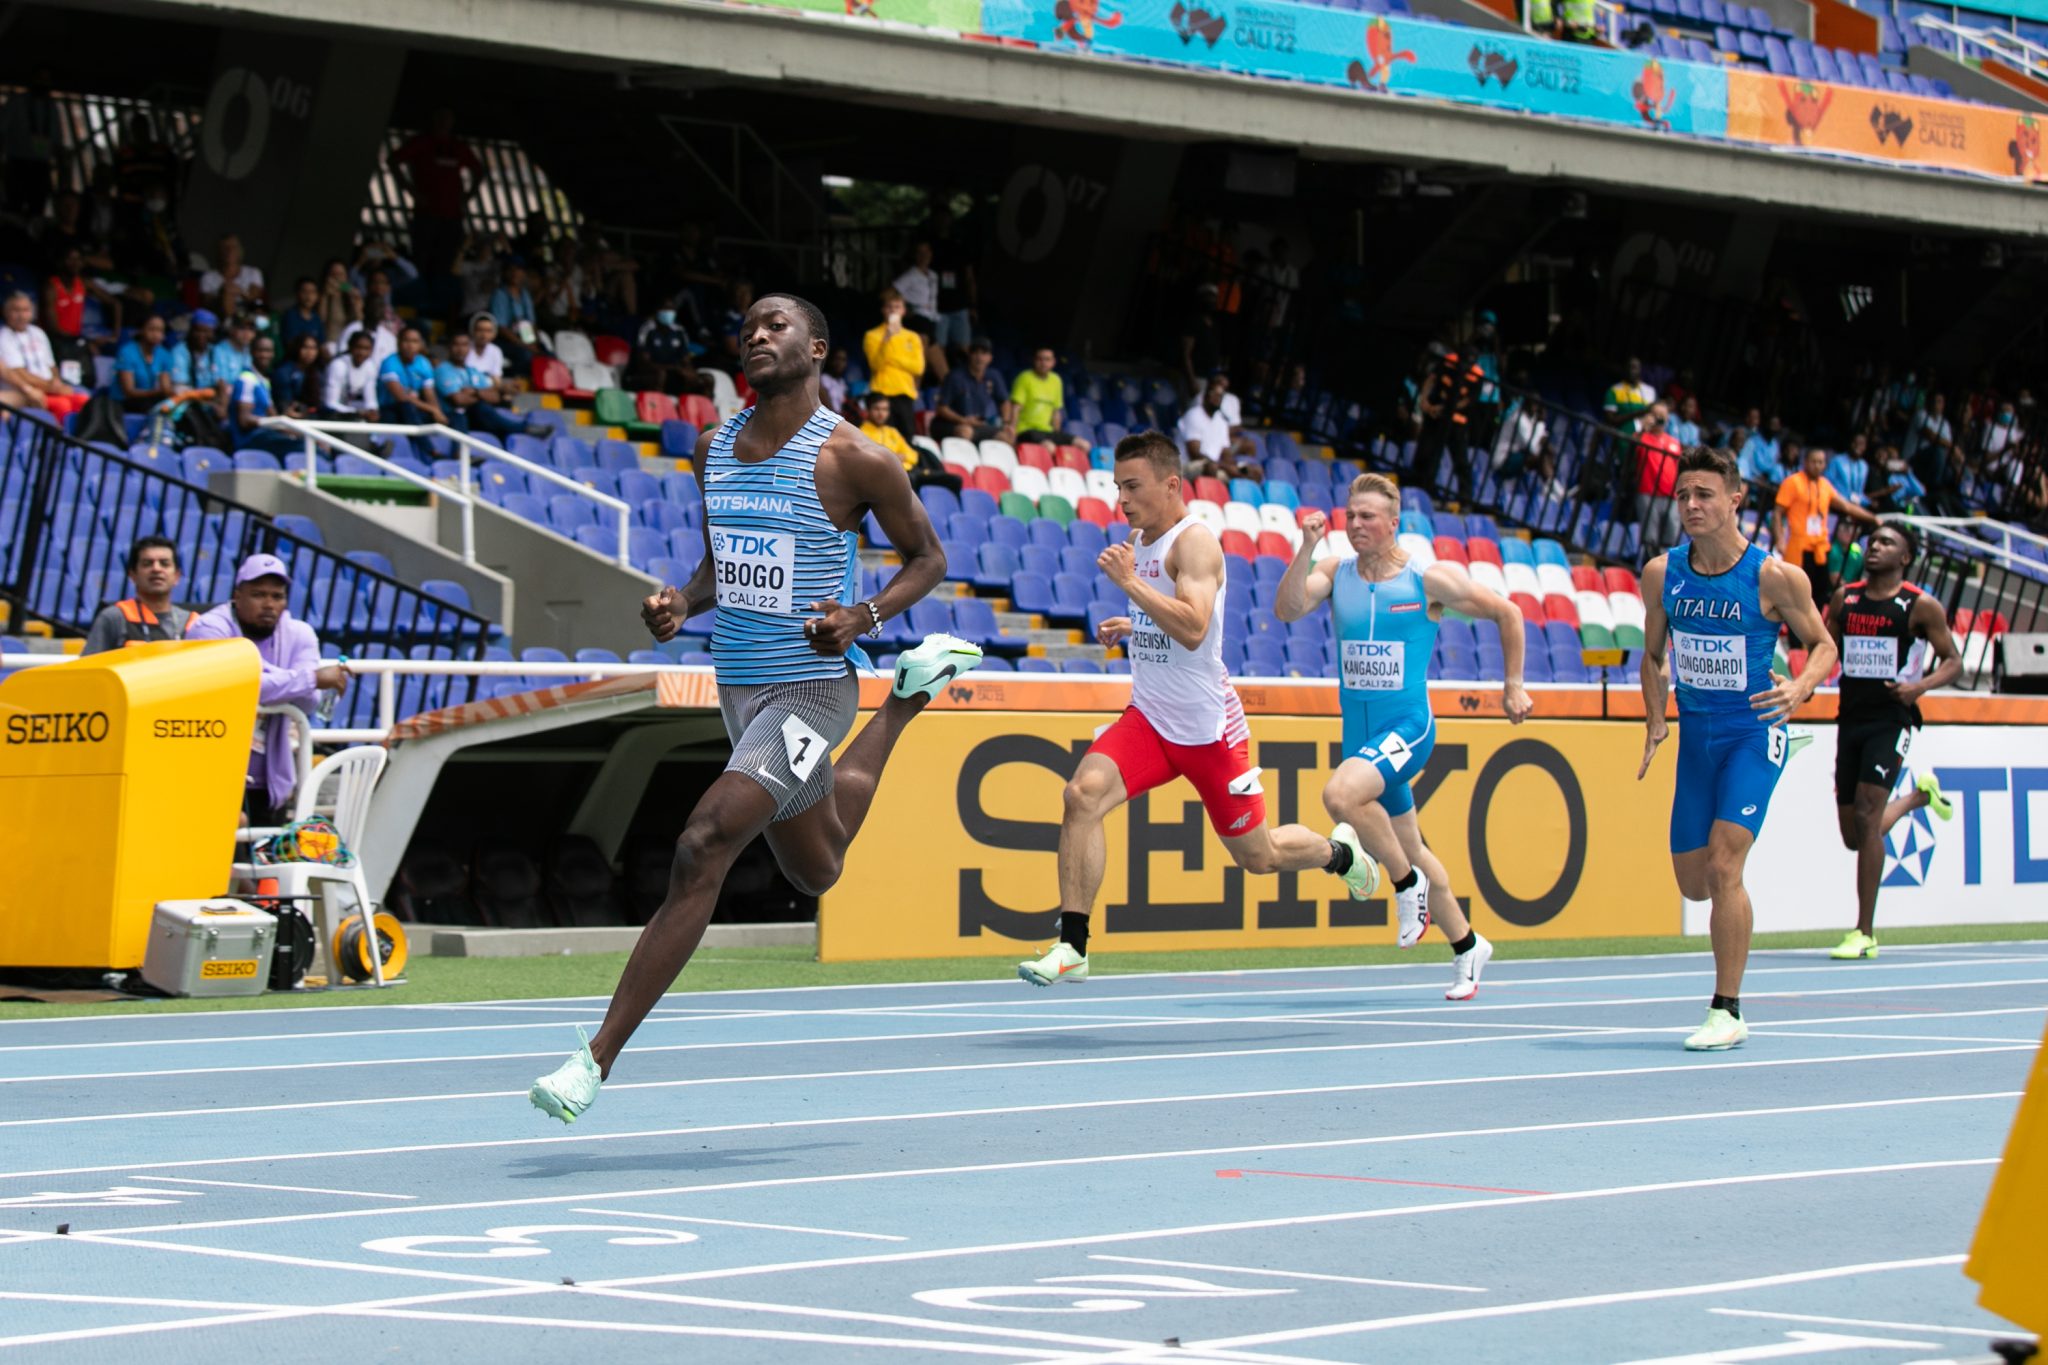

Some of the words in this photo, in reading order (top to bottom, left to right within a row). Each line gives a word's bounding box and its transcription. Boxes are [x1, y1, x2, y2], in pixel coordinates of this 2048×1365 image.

[1233, 27, 1271, 50] CALI
[1275, 32, 1298, 54] 22
[1525, 69, 1558, 91] CALI
[1561, 74, 1581, 94] 22
[1918, 127, 1947, 147] CALI
[1950, 131, 1966, 151] 22
[727, 533, 778, 557] TDK
[716, 560, 784, 590] EBOGO
[728, 592, 755, 606] CALI
[759, 595, 778, 608] 22
[1673, 598, 1742, 621] ITALIA
[1356, 644, 1392, 657] TDK
[1691, 637, 1734, 653] TDK
[1858, 639, 1888, 650] TDK
[1139, 652, 1155, 662] CALI
[1155, 654, 1169, 663] 22
[1677, 652, 1743, 676] LONGOBARDI
[1846, 653, 1894, 666] AUGUSTINE
[1343, 659, 1400, 676] KANGASOJA
[1359, 679, 1380, 688] CALI
[1381, 680, 1394, 688] 22
[1696, 677, 1721, 688] CALI
[1723, 678, 1738, 688] 22
[6, 711, 109, 744] SEIKO
[154, 719, 227, 738] SEIKO
[1389, 741, 1405, 755] 7
[1773, 735, 1783, 759] 5
[203, 962, 256, 976] SEIKO
